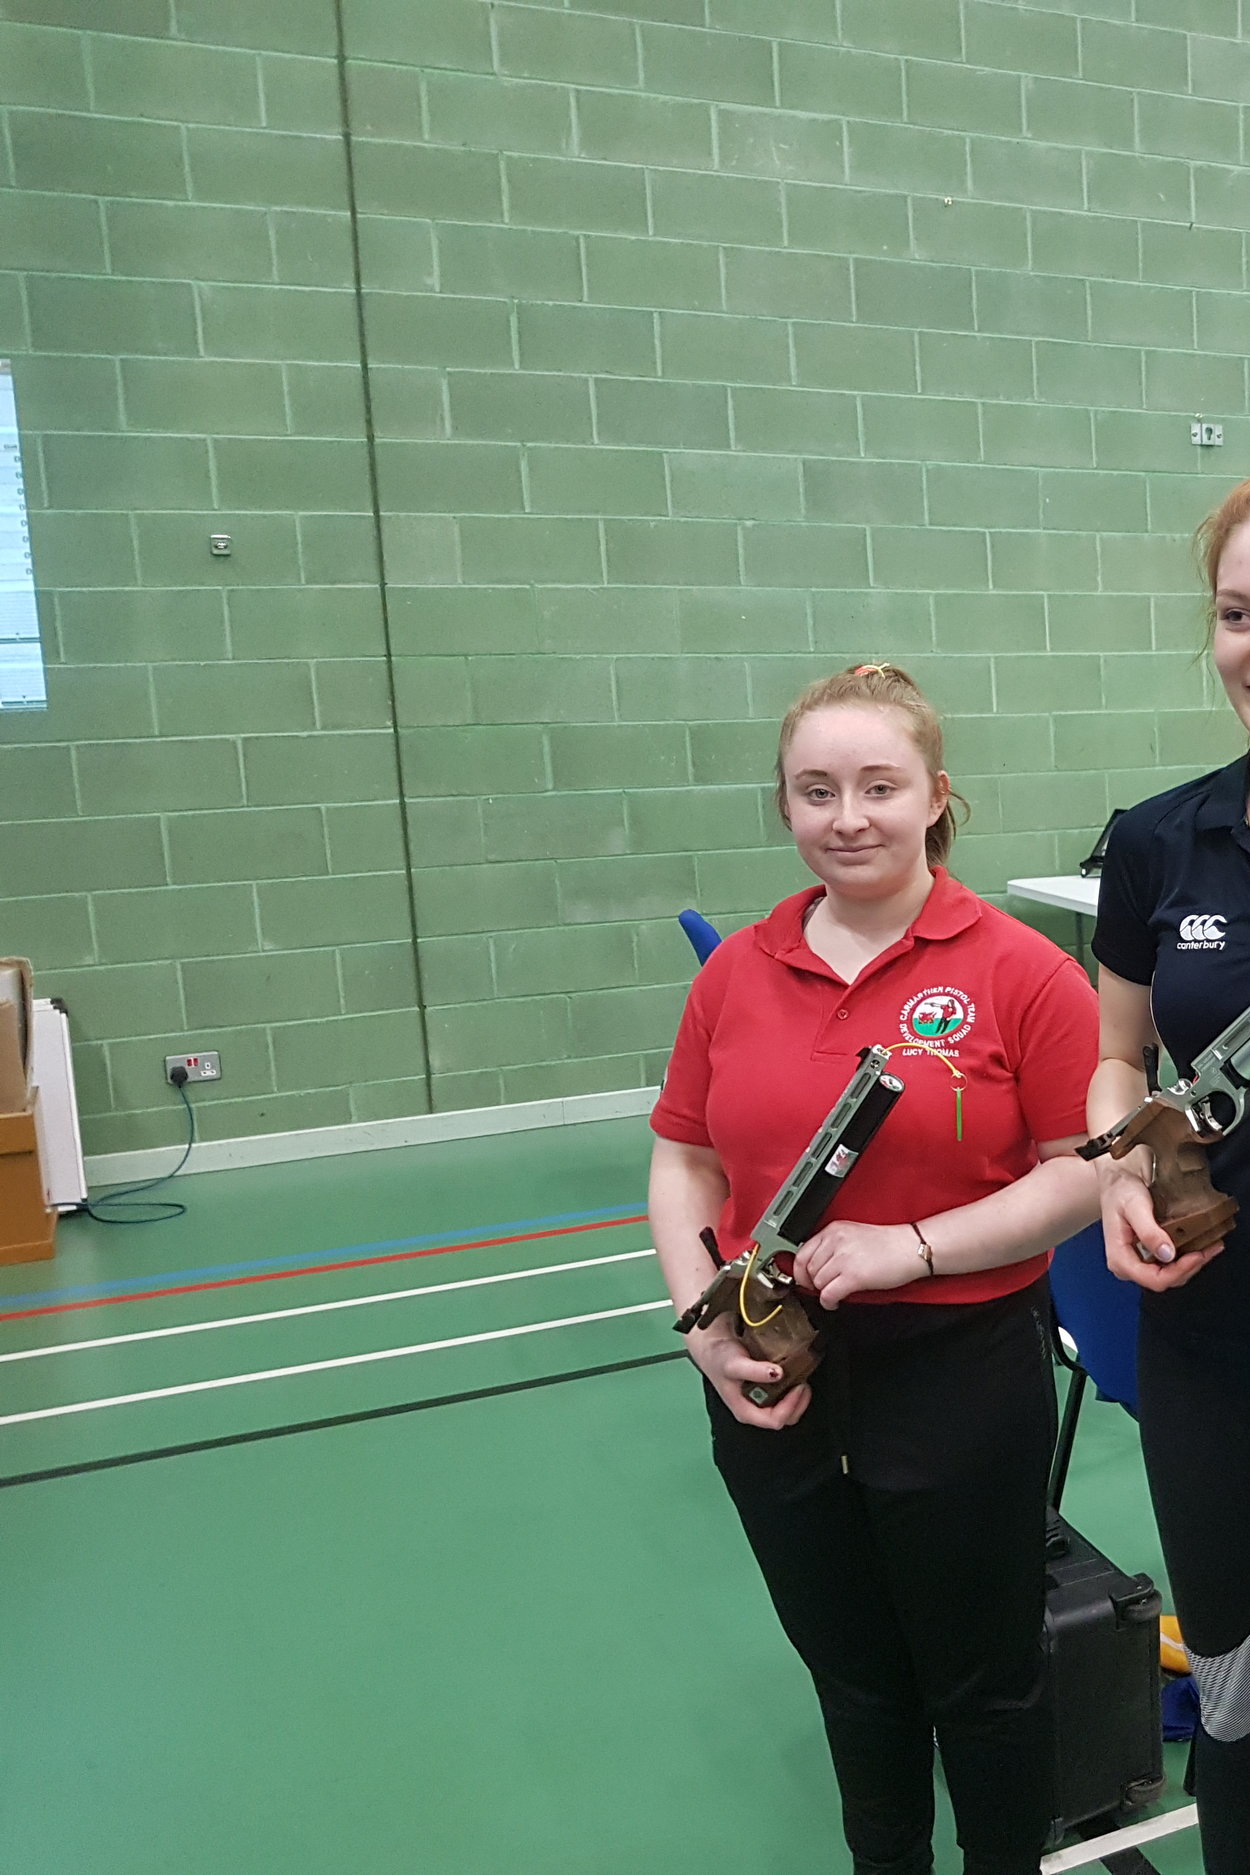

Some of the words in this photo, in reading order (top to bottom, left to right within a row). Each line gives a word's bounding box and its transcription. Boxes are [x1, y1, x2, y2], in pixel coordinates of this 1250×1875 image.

[1177, 940, 1226, 950] canterbury
[900, 986, 943, 1020] CARMARTHEN
[945, 987, 971, 1004] PISTOL
[899, 1024, 945, 1047] DEVELOPMENT
[947, 1024, 971, 1044] SQUAD
[902, 1048, 923, 1056] LUCY
[927, 1048, 960, 1057] THOMAS
